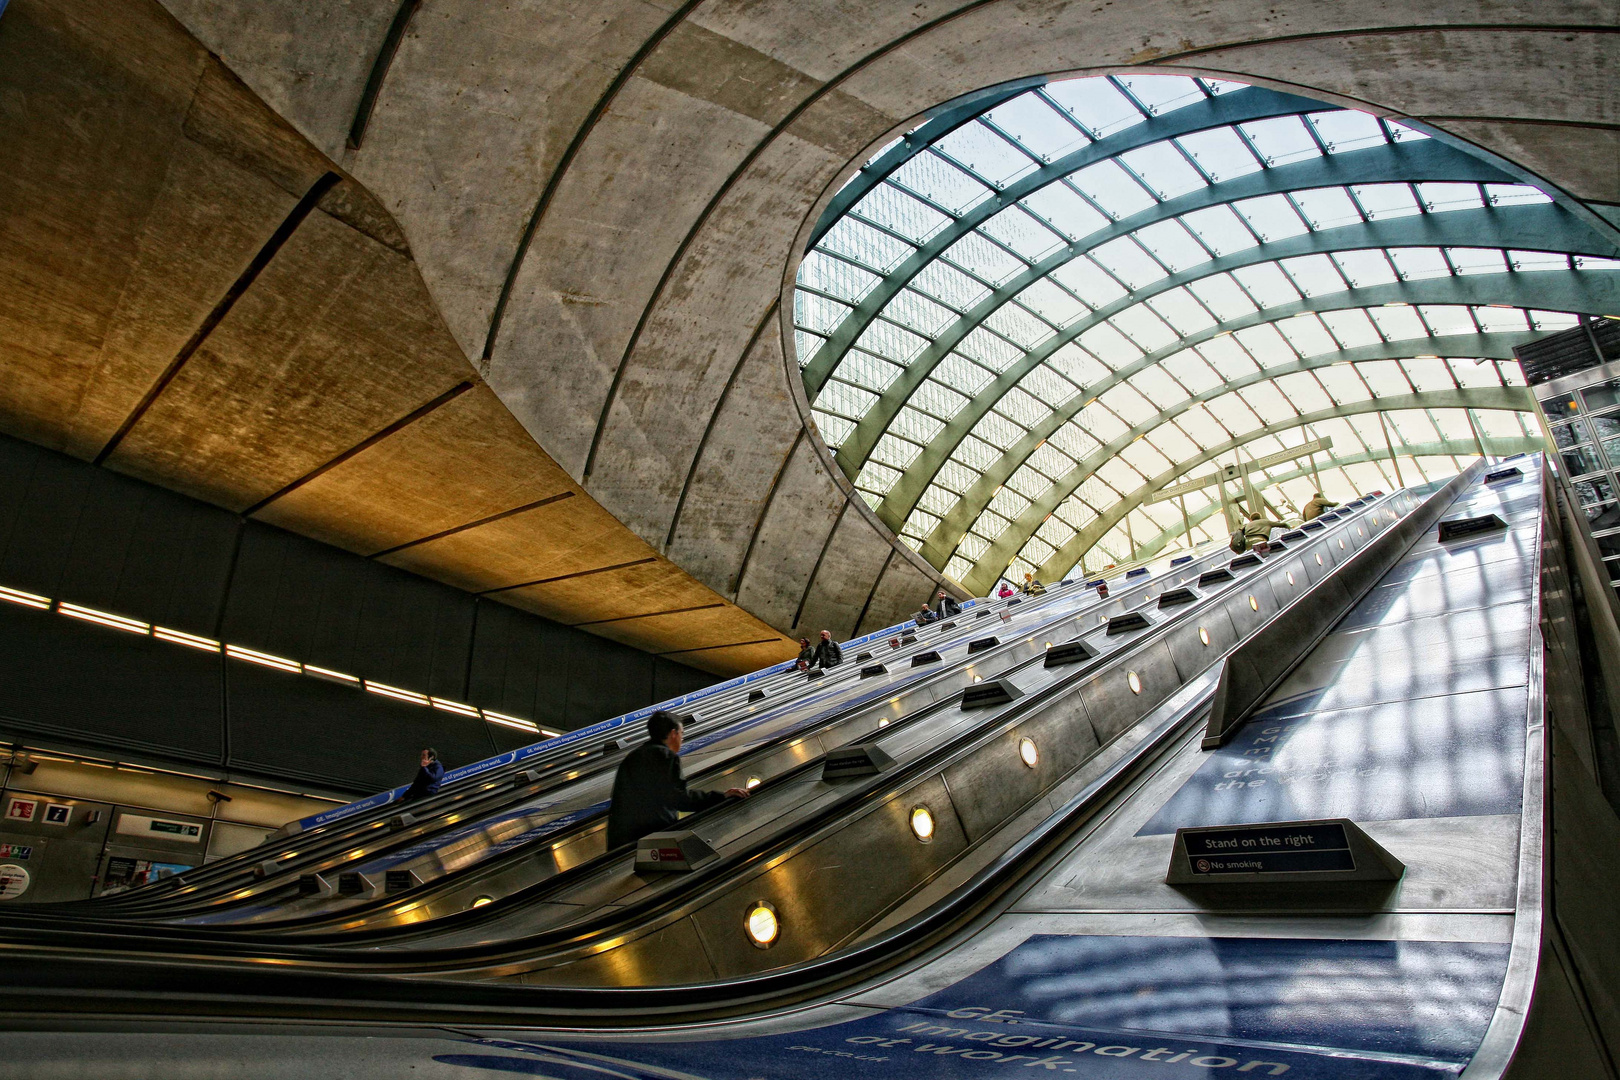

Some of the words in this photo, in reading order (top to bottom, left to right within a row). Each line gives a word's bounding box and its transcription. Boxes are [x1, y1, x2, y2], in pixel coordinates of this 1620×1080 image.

[1213, 779, 1266, 791] the
[325, 806, 356, 820] Imagination
[1205, 837, 1238, 849] Stand
[1241, 838, 1256, 848] on
[1259, 835, 1281, 847] the
[1284, 833, 1315, 847] right
[1211, 860, 1224, 870] No
[1226, 859, 1263, 871] smoking
[843, 1032, 913, 1049] at
[913, 1041, 1078, 1073] work.
[895, 1021, 1292, 1077] Imagination
